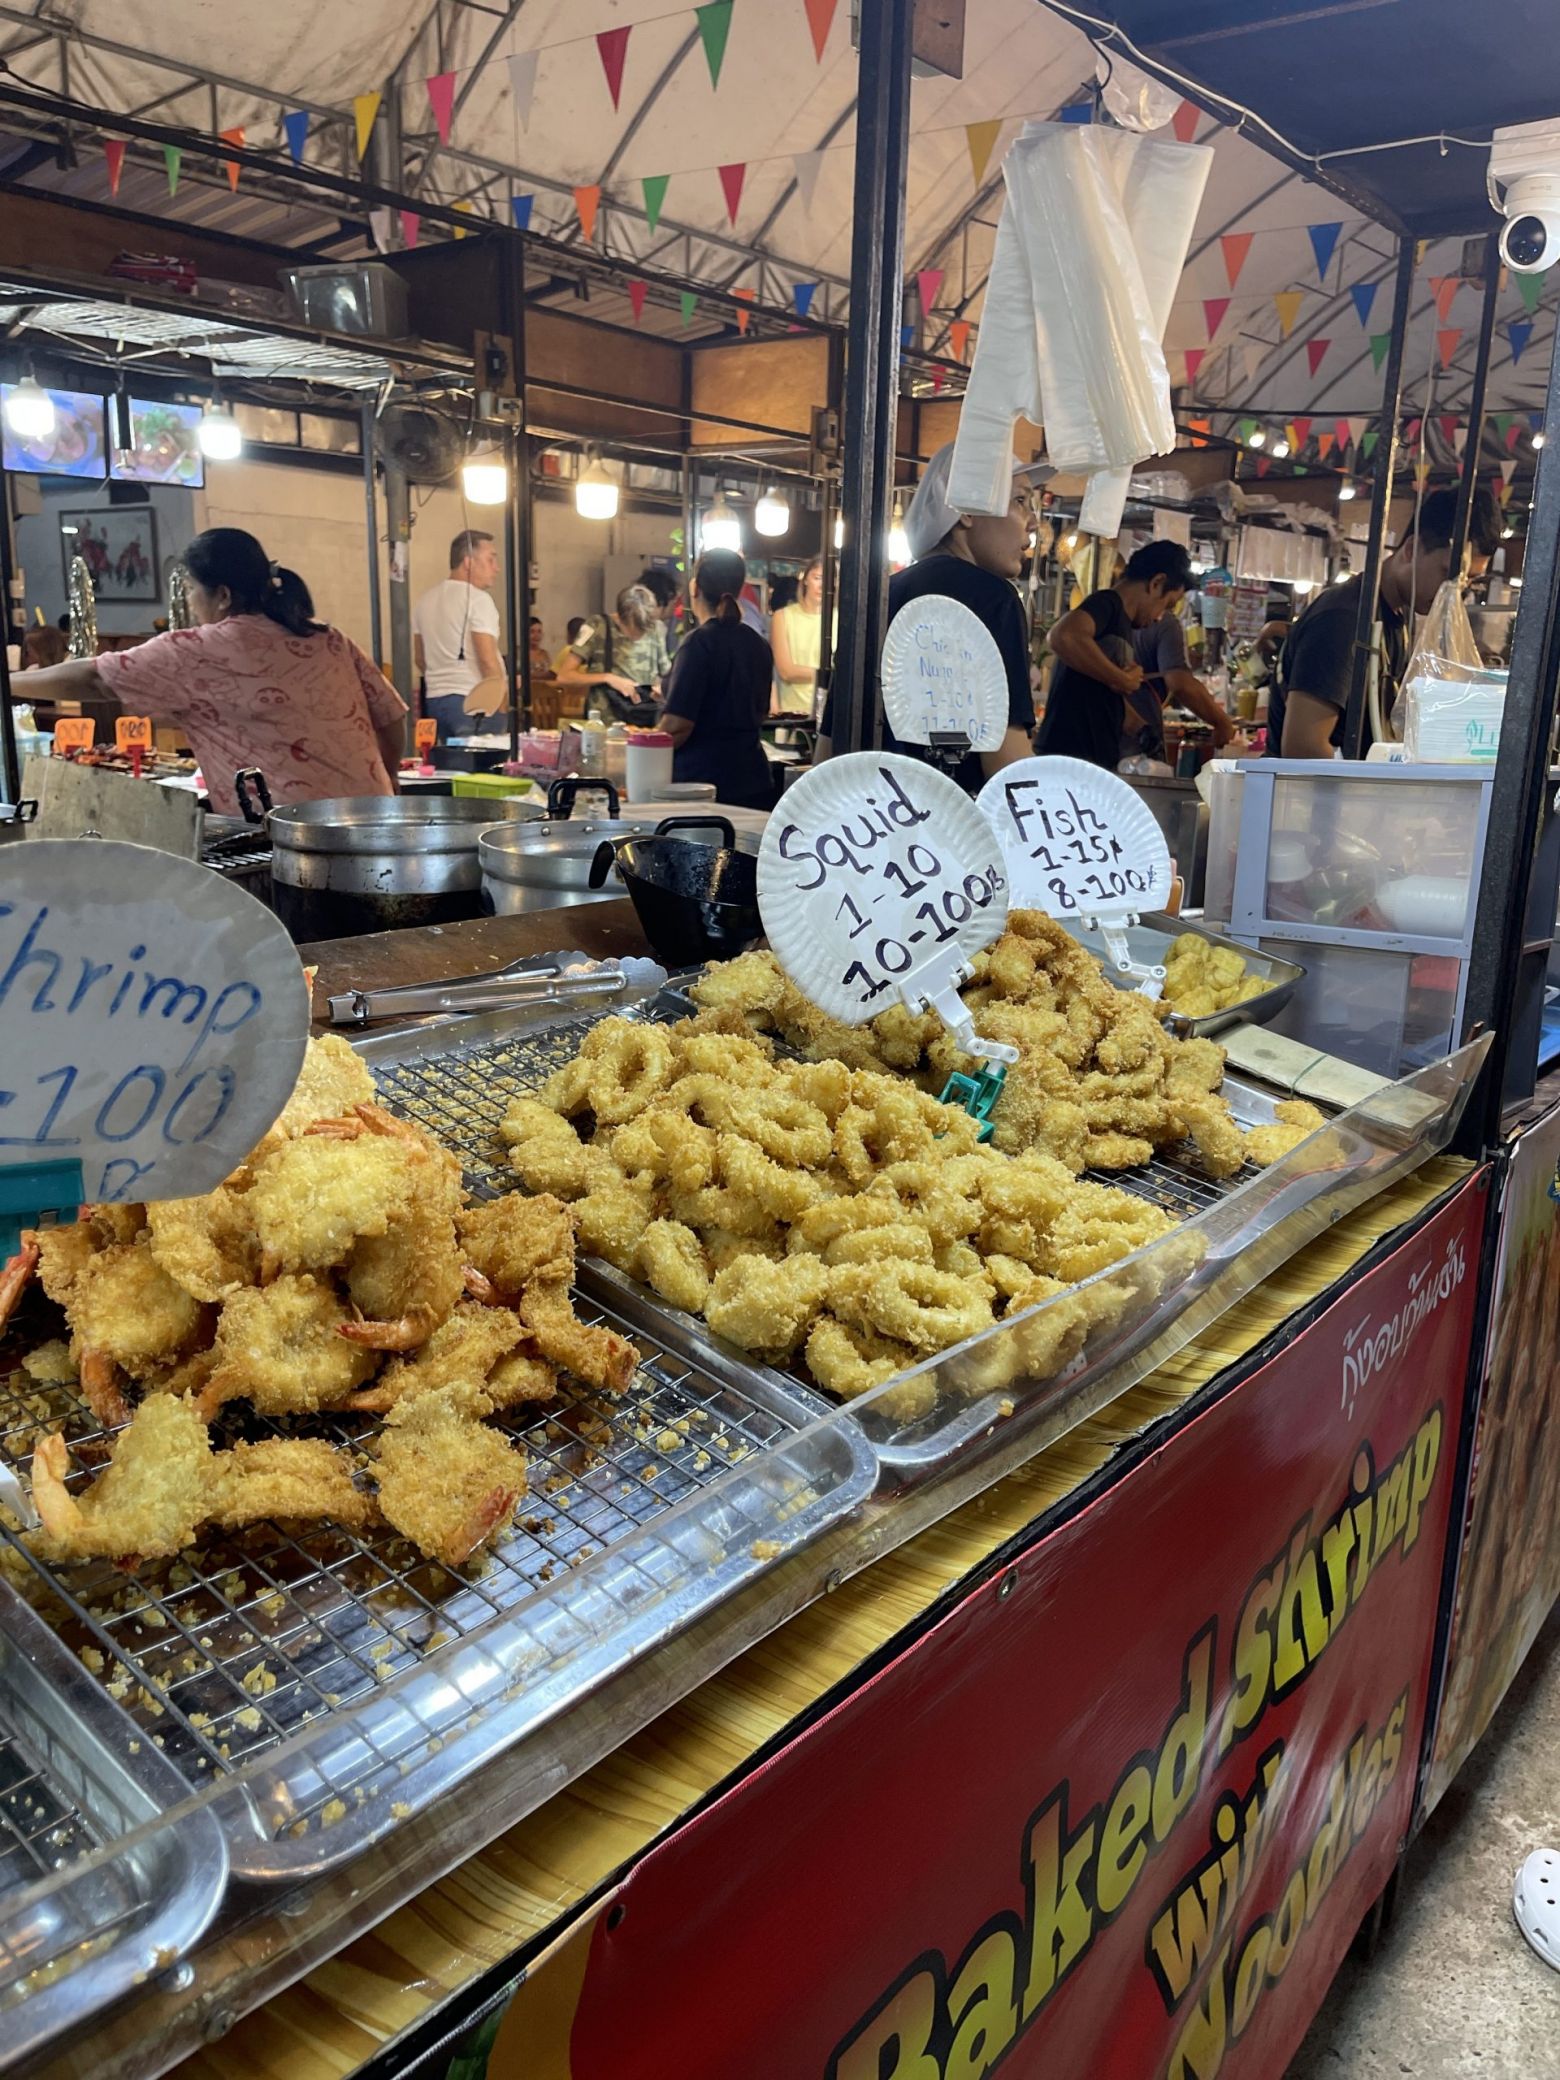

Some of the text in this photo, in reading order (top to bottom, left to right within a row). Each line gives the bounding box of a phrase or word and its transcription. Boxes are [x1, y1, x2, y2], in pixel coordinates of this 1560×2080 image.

[779, 767, 932, 890] Squid
[1005, 780, 1109, 843] Fish
[0, 904, 262, 1078] hrimp
[826, 1613, 1219, 2080] Baked
